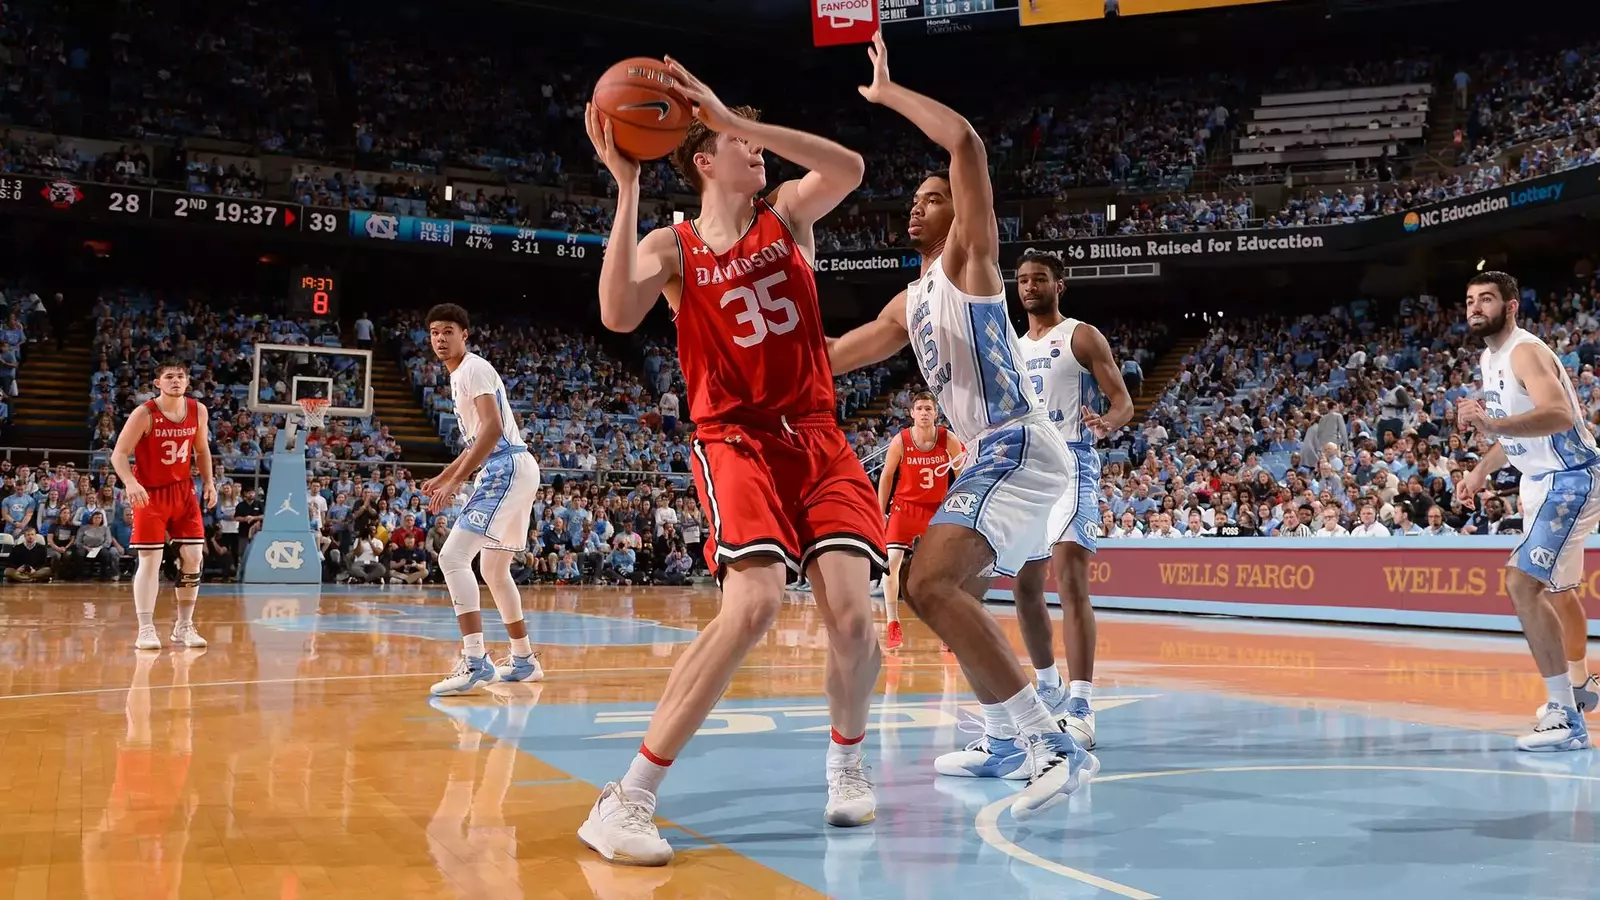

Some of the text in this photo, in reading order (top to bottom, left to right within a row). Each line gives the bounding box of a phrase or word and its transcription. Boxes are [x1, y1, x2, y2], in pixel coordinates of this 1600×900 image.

[820, 0, 868, 12] FANFOOD
[890, 8, 907, 19] MAYE
[945, 5, 956, 14] 10
[964, 2, 970, 12] 3
[982, 0, 987, 10] 1
[926, 18, 950, 26] Honda
[108, 192, 139, 213] 28
[1420, 182, 1565, 228] NC Education Lottery
[174, 198, 278, 226] 2ND 19:37
[309, 212, 337, 233] 39
[469, 224, 491, 236] FG%
[517, 229, 536, 240] 3PT
[566, 234, 578, 244] FT
[465, 235, 493, 250] 47%
[511, 240, 540, 255] 3-11
[1068, 245, 1085, 260] $6
[1090, 243, 1142, 259] Billion
[1147, 239, 1202, 256] Raised
[1207, 238, 1232, 253] for
[1237, 234, 1324, 252] Education
[556, 244, 585, 259] 8-10
[695, 238, 791, 286] DAVIDSON
[830, 256, 899, 272] Education
[302, 277, 333, 290] 19:37
[313, 292, 328, 315] 8
[719, 270, 800, 348] 35
[155, 426, 197, 438] DAVIDSON
[160, 439, 190, 465] 34
[906, 455, 945, 465] DAVIDSON
[919, 467, 934, 489] 3
[1222, 527, 1239, 536] POSS
[1159, 562, 1315, 590] WELLS FARGO
[1383, 566, 1487, 596] WELLS
